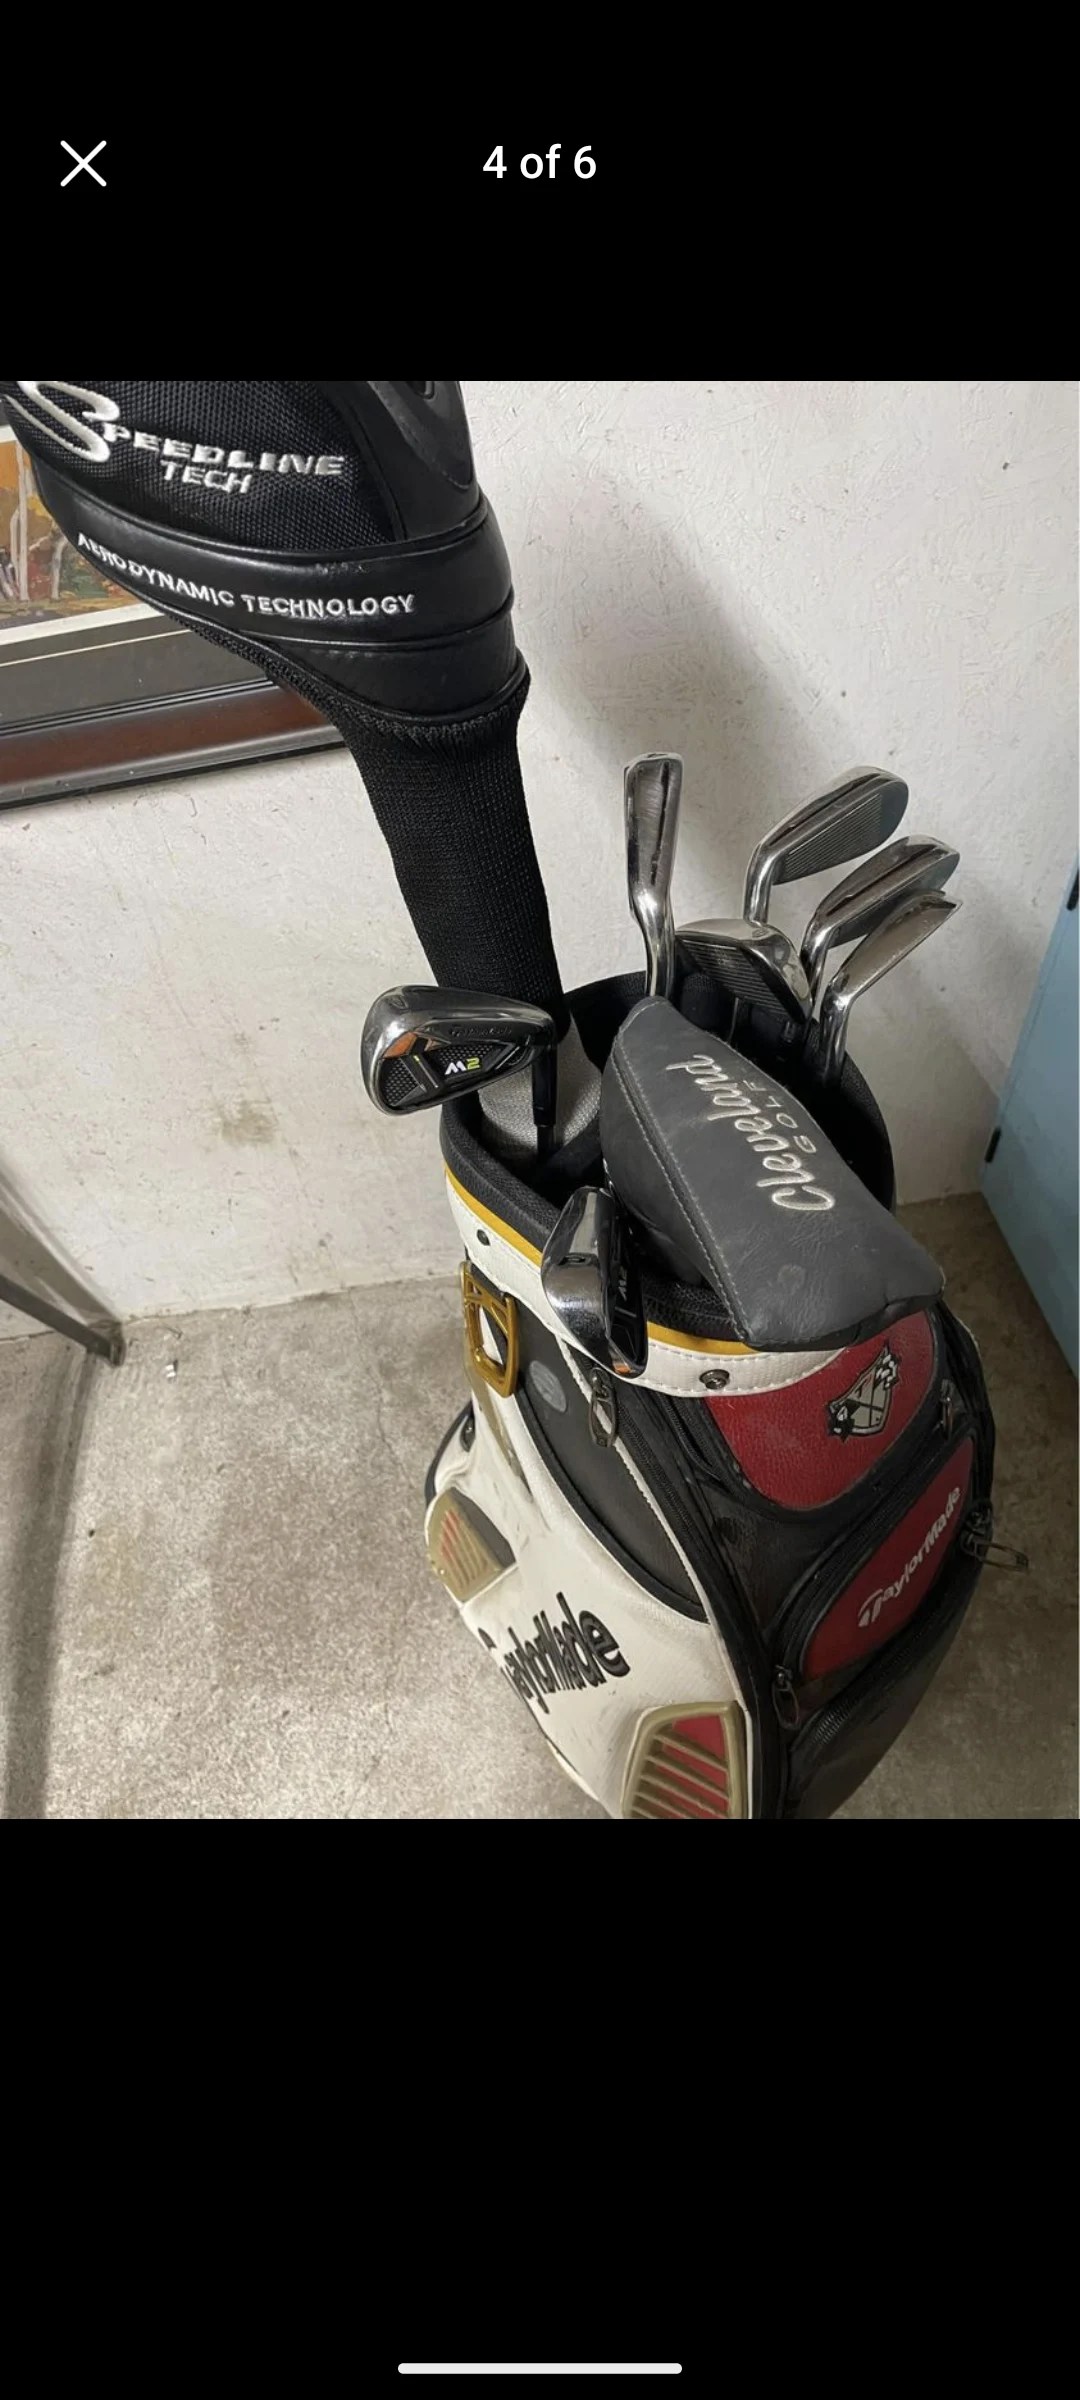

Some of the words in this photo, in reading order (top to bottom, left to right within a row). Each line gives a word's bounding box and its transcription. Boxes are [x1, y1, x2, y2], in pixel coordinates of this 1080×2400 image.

[160, 460, 252, 493] TECH
[78, 532, 235, 607] AERODYNAMIC
[240, 593, 415, 618] TECHNOLOGY
[444, 1057, 481, 1075] M2
[666, 1055, 836, 1212] Cleveland
[743, 1079, 817, 1154] GOLF
[858, 1486, 961, 1628] TaylorMade
